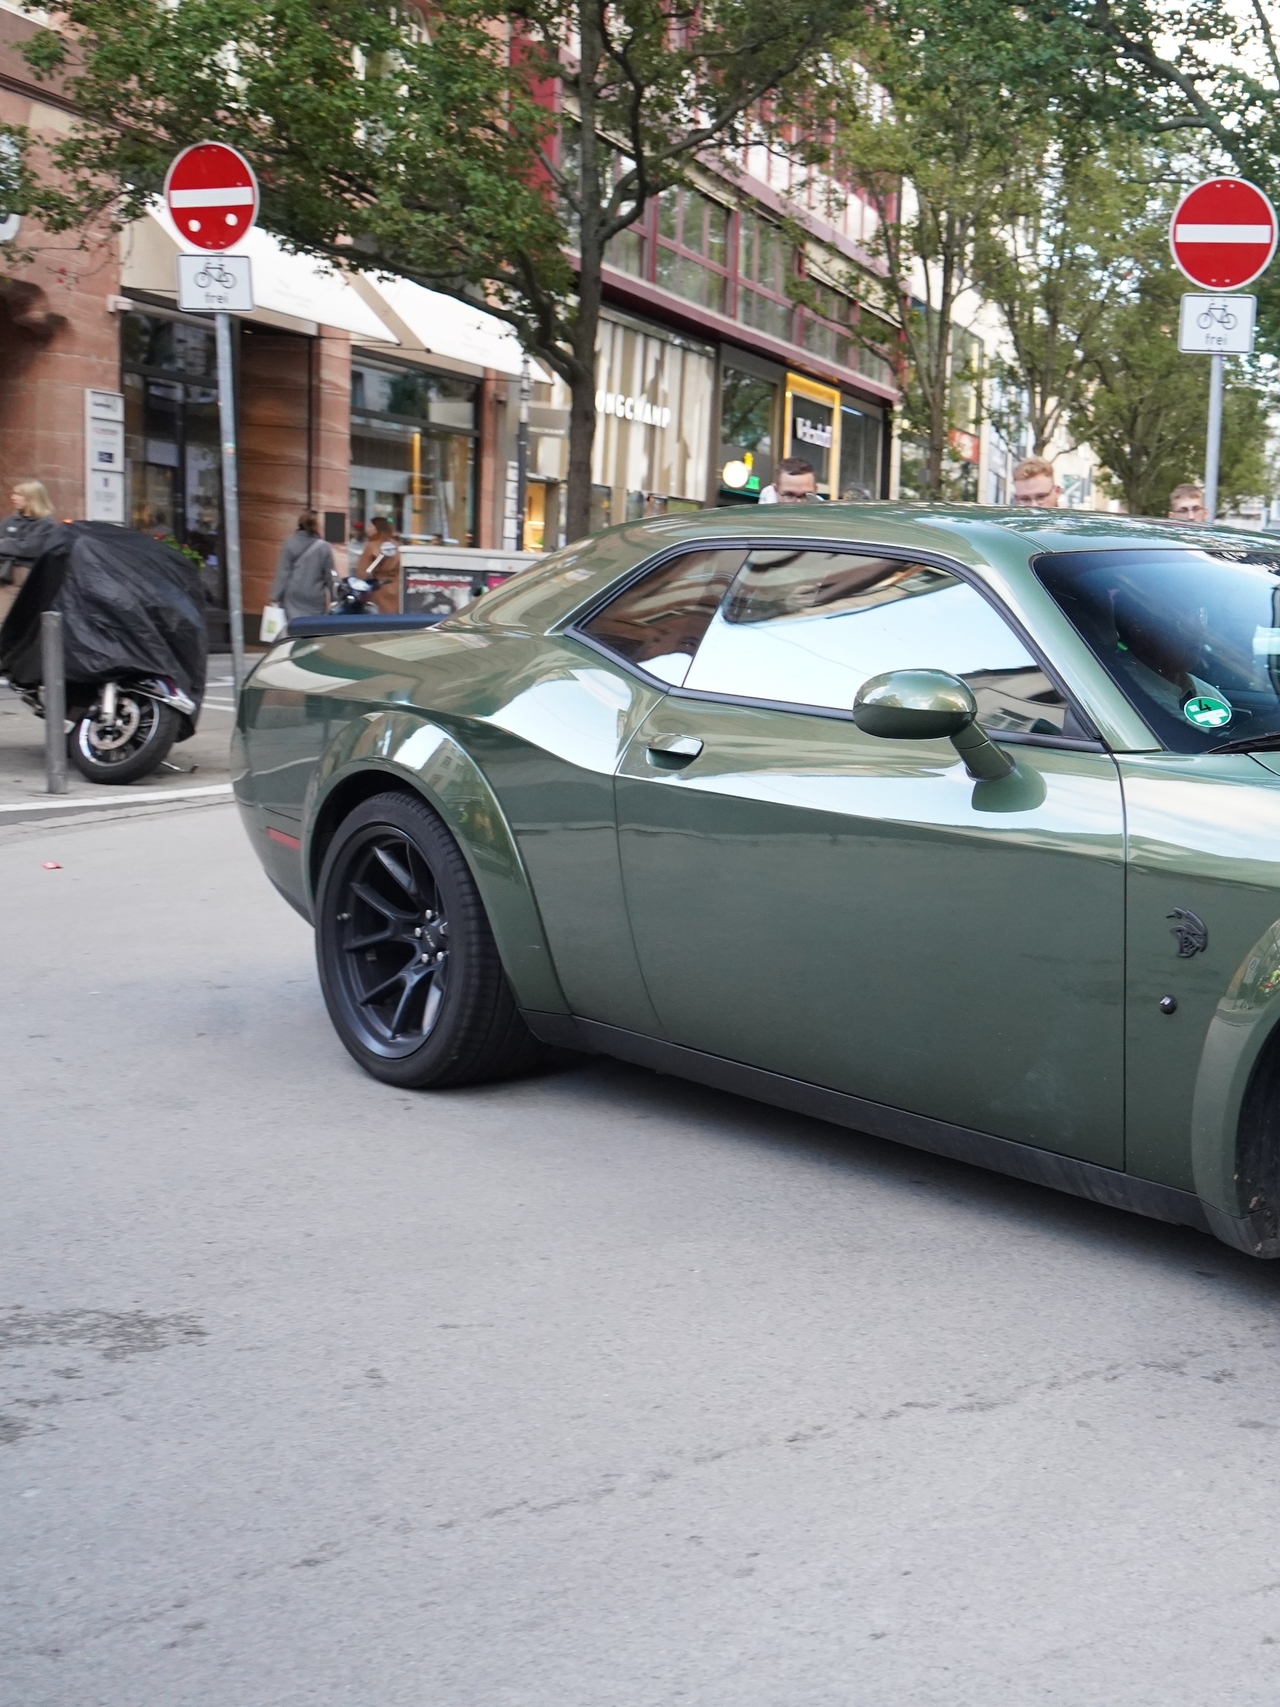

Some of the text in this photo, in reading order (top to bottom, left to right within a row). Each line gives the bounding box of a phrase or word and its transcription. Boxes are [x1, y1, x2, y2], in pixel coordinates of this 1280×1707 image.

[1205, 333, 1228, 346] frei
[594, 389, 672, 428] ONGCHAMP
[1198, 699, 1212, 711] 4
